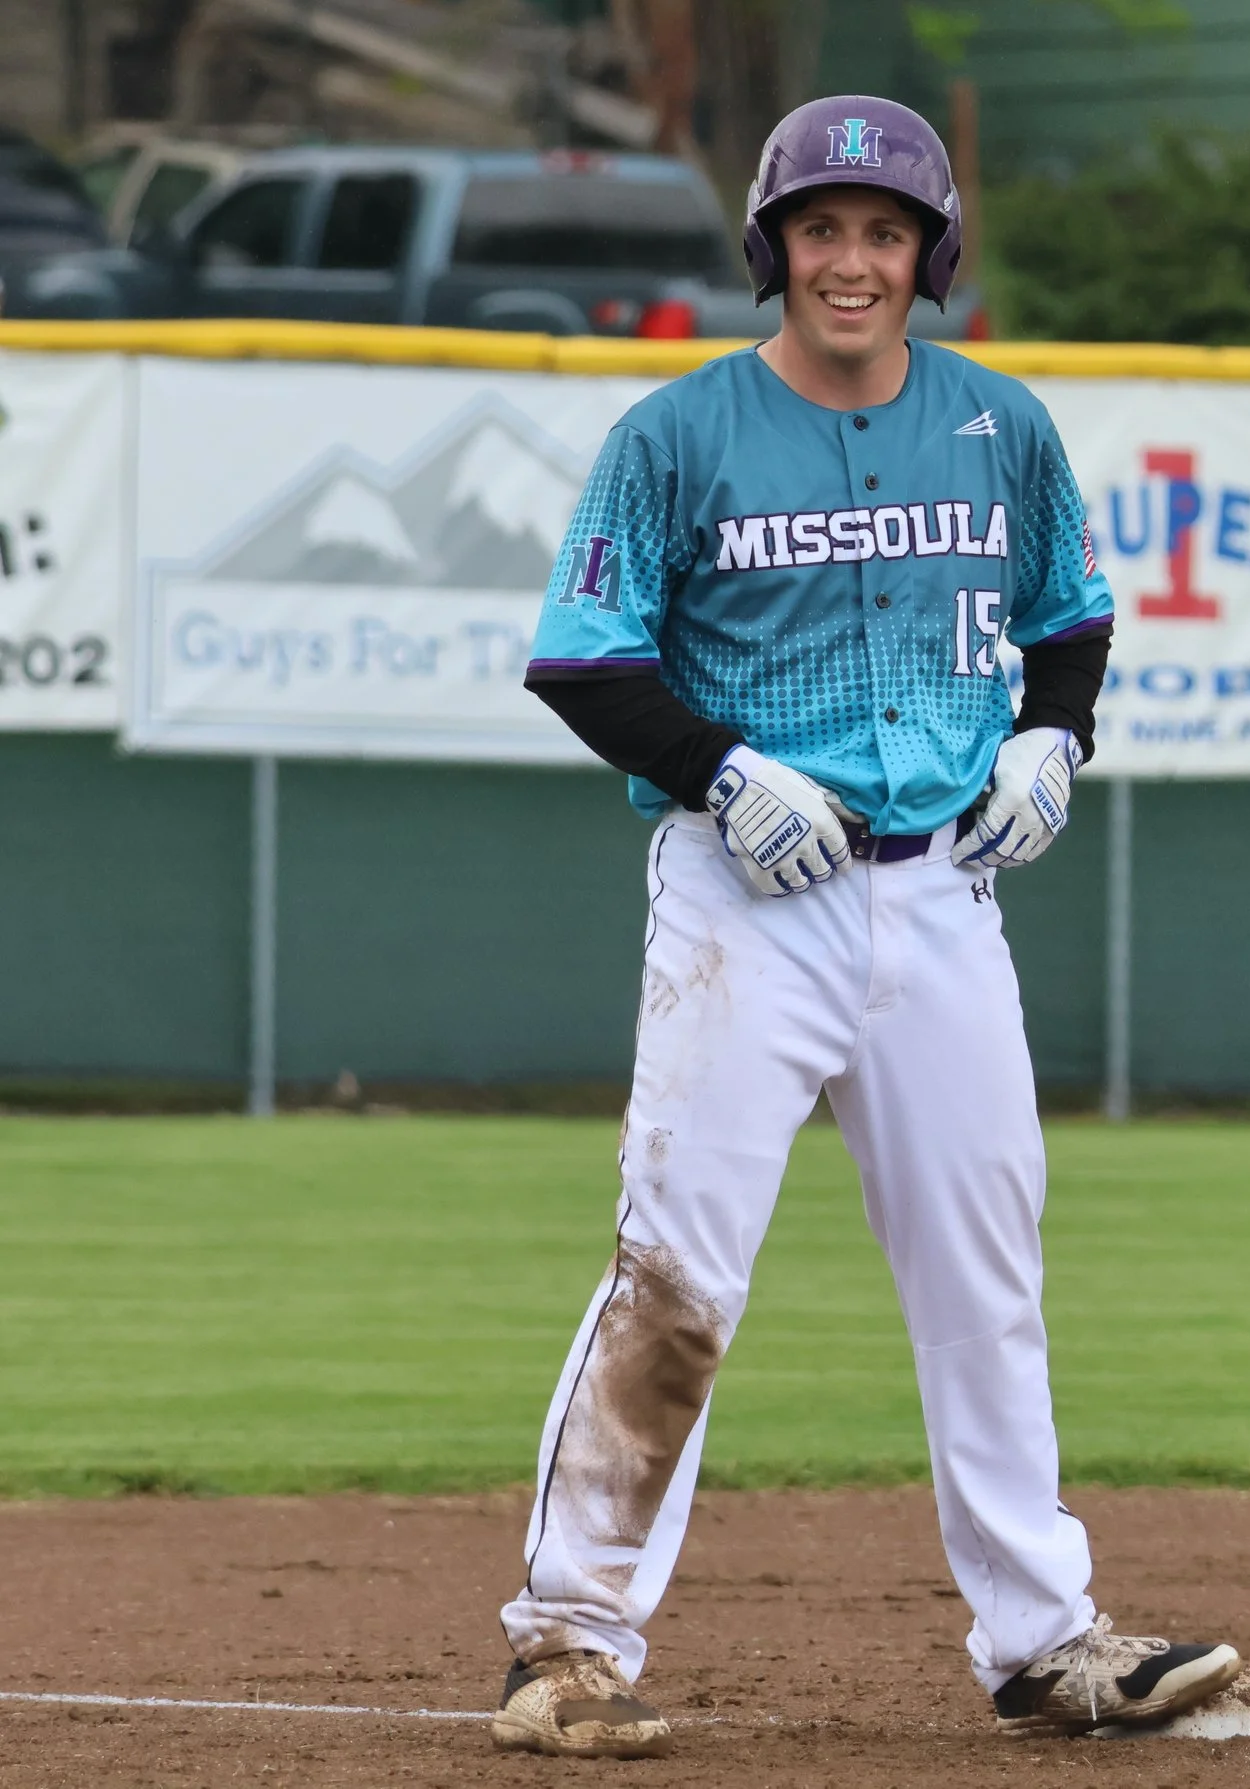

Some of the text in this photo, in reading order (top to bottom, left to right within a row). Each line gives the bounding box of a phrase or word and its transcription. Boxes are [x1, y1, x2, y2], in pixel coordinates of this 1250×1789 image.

[715, 501, 1008, 571] MISSOULA
[174, 609, 333, 688] Guys
[348, 614, 446, 676] For
[953, 588, 1001, 677] 15
